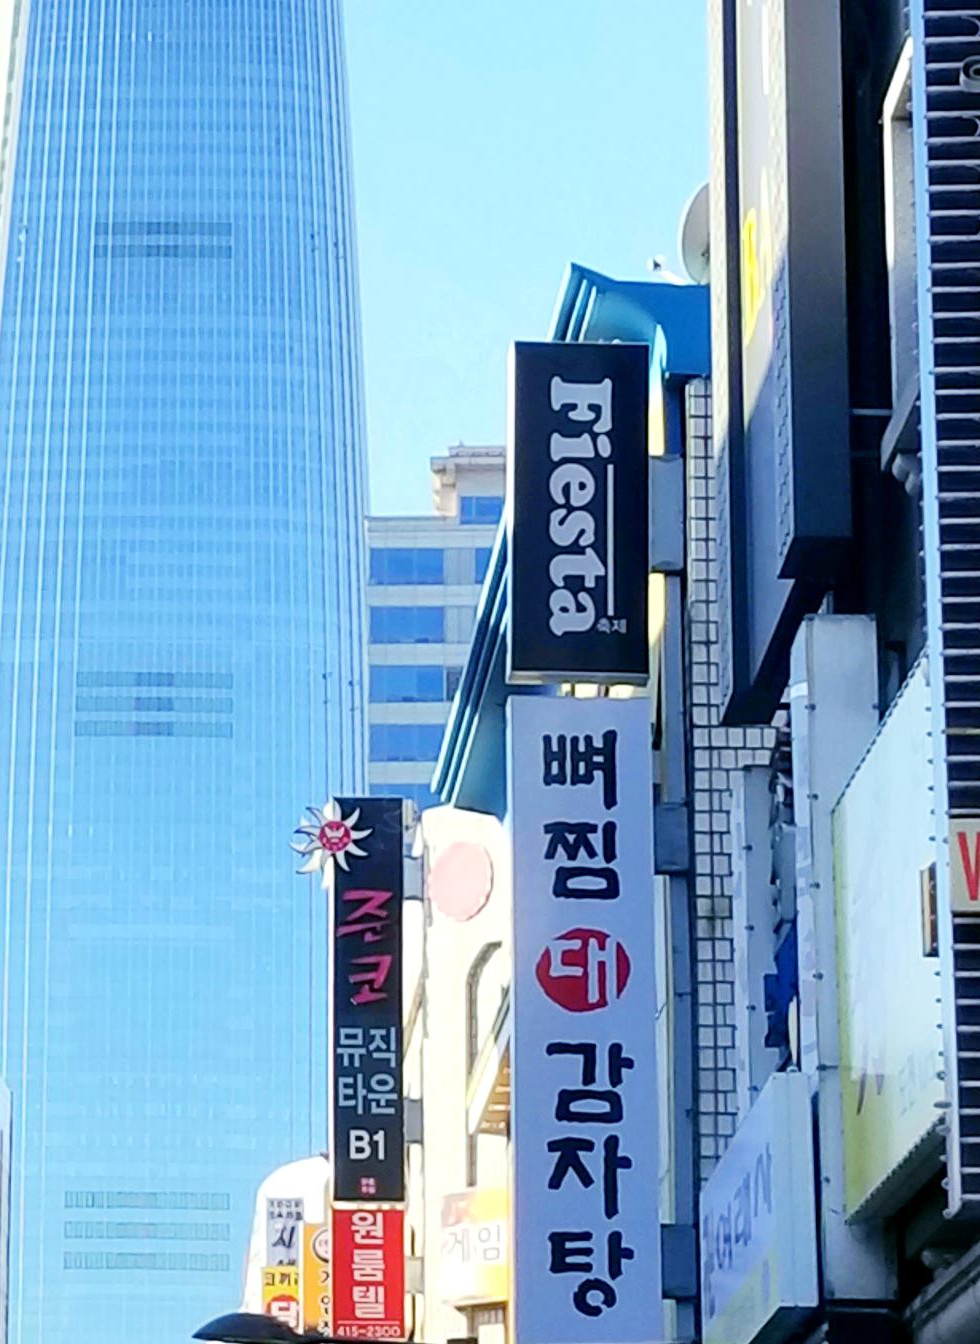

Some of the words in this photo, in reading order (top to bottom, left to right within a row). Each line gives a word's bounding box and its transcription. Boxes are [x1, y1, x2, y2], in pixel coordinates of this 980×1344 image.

[549, 375, 613, 637] Fiesta
[336, 888, 395, 1006] 준코
[336, 1026, 396, 1068] 뮤직
[337, 1074, 398, 1115] 타운
[348, 1130, 386, 1160] B1
[351, 1211, 385, 1319] 원룸텔
[337, 1325, 402, 1339] 415-2300
